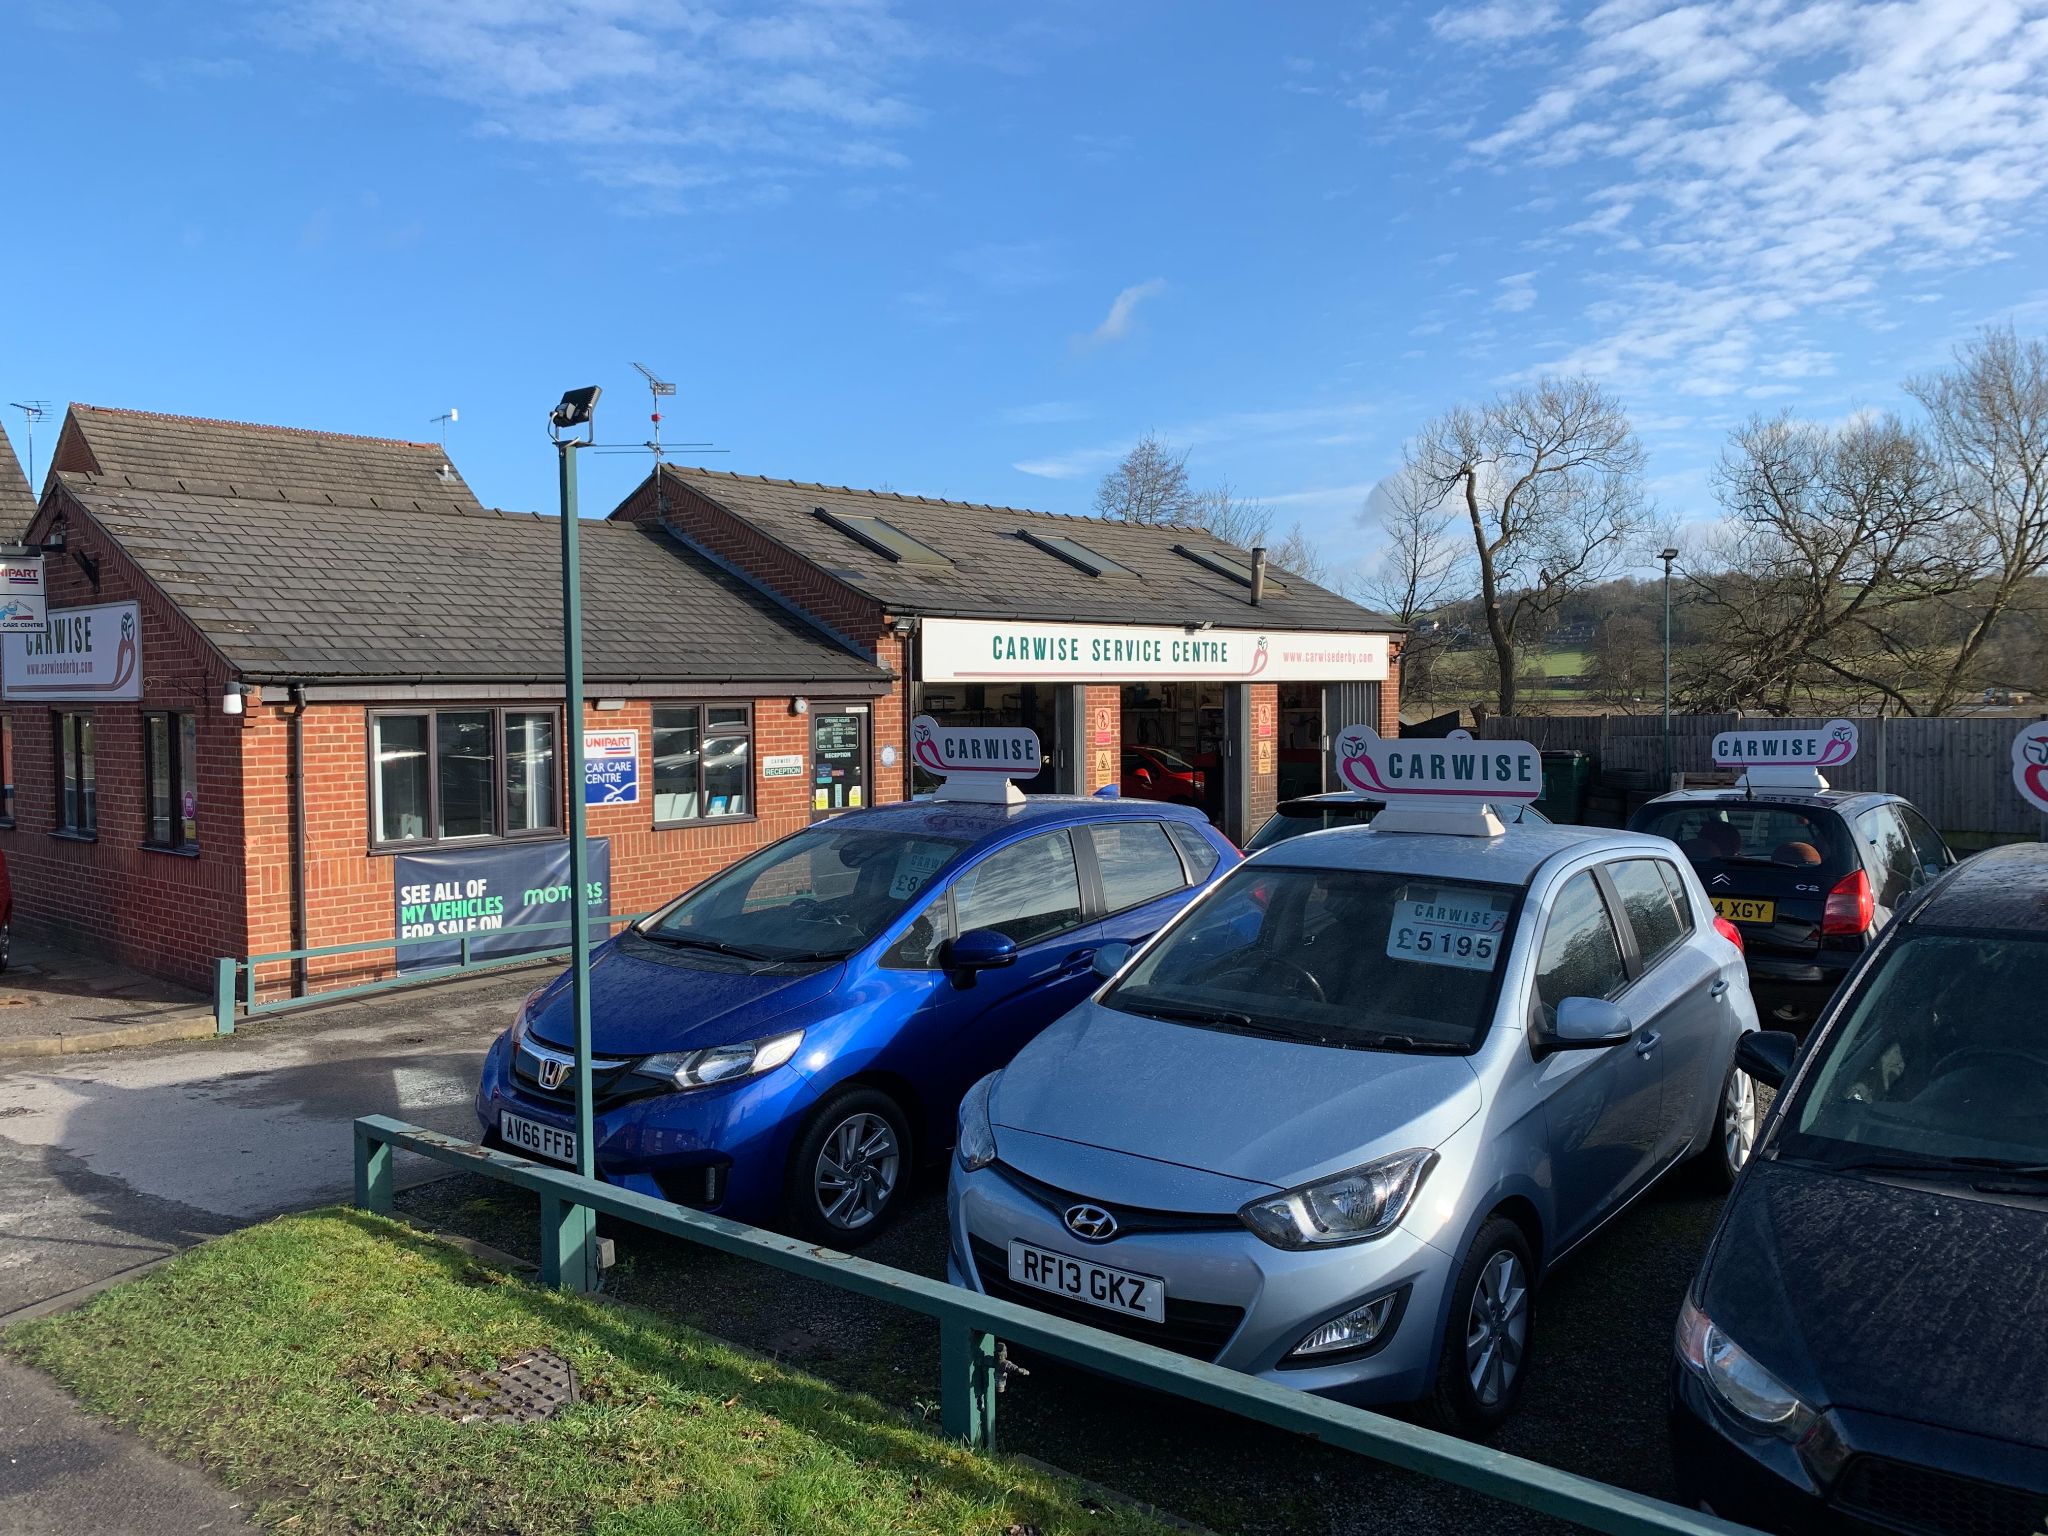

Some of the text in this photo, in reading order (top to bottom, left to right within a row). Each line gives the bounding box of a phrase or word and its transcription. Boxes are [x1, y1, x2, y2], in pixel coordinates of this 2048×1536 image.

[0, 568, 38, 578] NIPART
[26, 616, 92, 656] CARWISE
[992, 635, 1228, 662] CARWISE SERVICE CENTRE
[1283, 650, 1374, 665] www.carwisederby.com
[26, 661, 93, 675] www.carwisederby.com
[585, 737, 631, 747] UNIPART
[945, 739, 1033, 761] CARWISE
[1718, 739, 1816, 757] CARWISE
[585, 762, 632, 773] CAR CARE
[765, 768, 801, 776] RECEPTION
[1389, 753, 1531, 781] CARWISE
[585, 773, 621, 784] CENTRE
[401, 879, 487, 905] SEE ALL OF
[1795, 884, 1819, 892] C2
[402, 896, 504, 925] MY VEHICLES
[1414, 904, 1490, 925] CARWISE
[1730, 903, 1766, 918] XGY
[1396, 927, 1493, 959] £5195
[506, 1116, 574, 1159] AV66 FFB
[1024, 1250, 1146, 1312] RF13 GKZ
